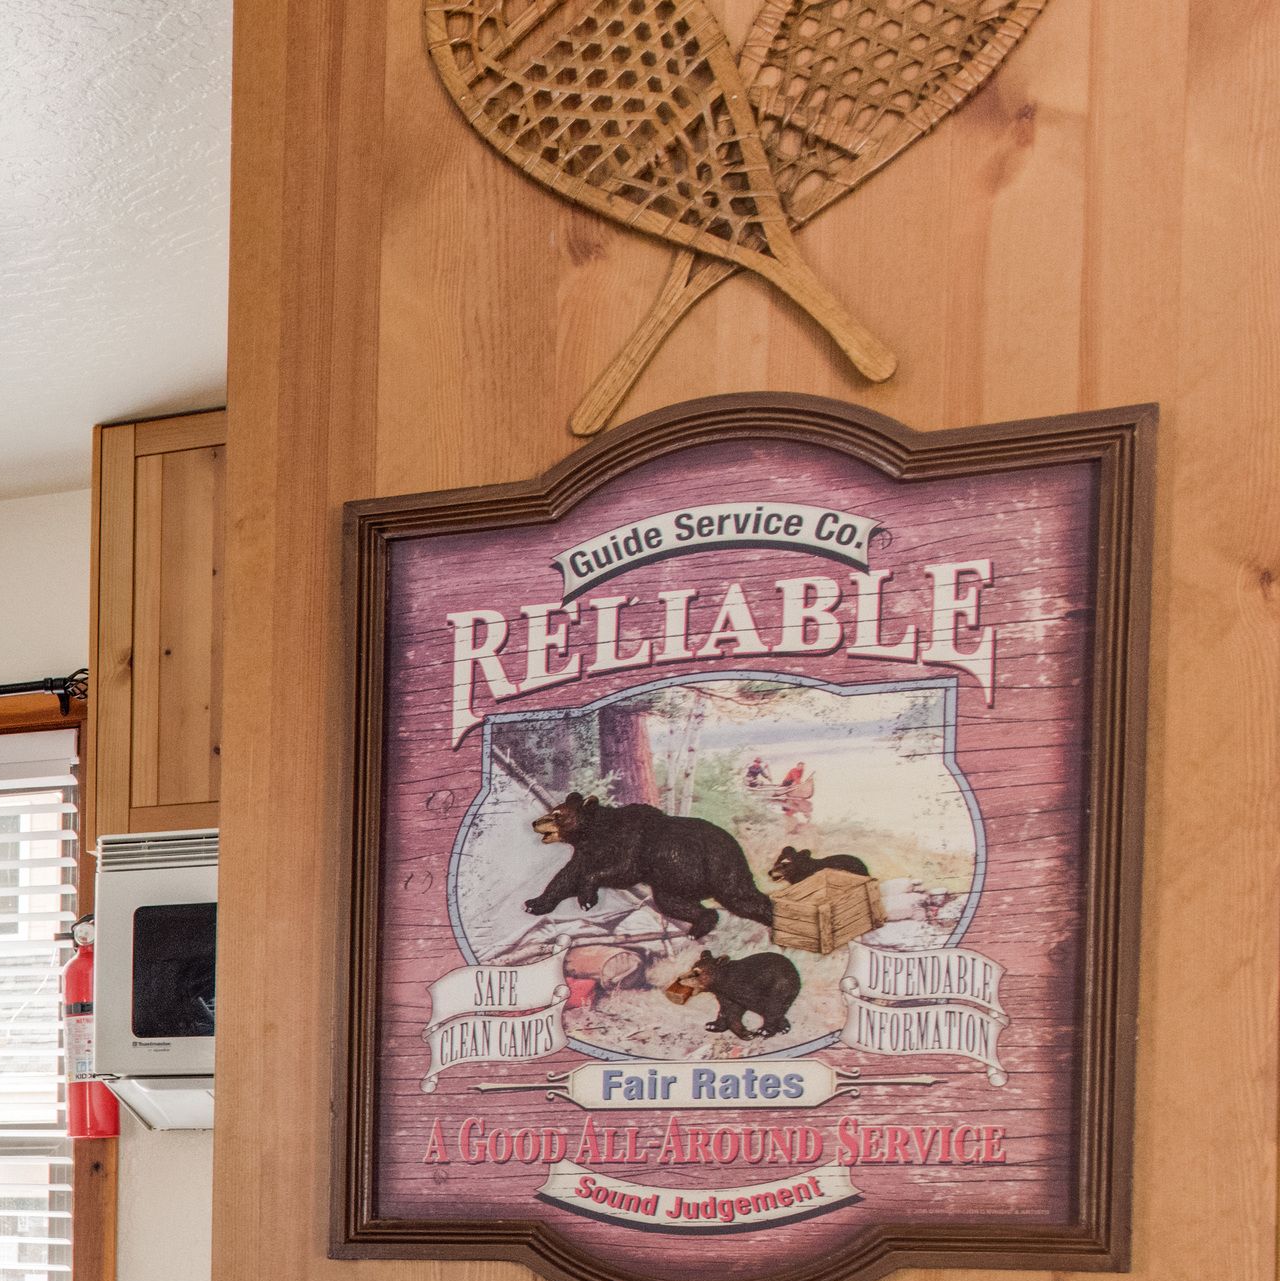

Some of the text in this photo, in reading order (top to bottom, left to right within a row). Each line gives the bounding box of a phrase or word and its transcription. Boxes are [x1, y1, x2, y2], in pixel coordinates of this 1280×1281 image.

[568, 505, 864, 578] Guide Service Co.
[445, 557, 997, 752] RELIABLE
[474, 970, 518, 1007] SAFE
[868, 951, 993, 1004] DEPENDABLE
[440, 1014, 554, 1066] CLEAN CAMPS
[856, 1005, 990, 1059] INFORMATION
[602, 1067, 805, 1101] Fair Rates
[423, 1114, 1008, 1167] A GOOD ALL-AROUND SERVICE
[573, 1175, 827, 1223] Sound Judgement
